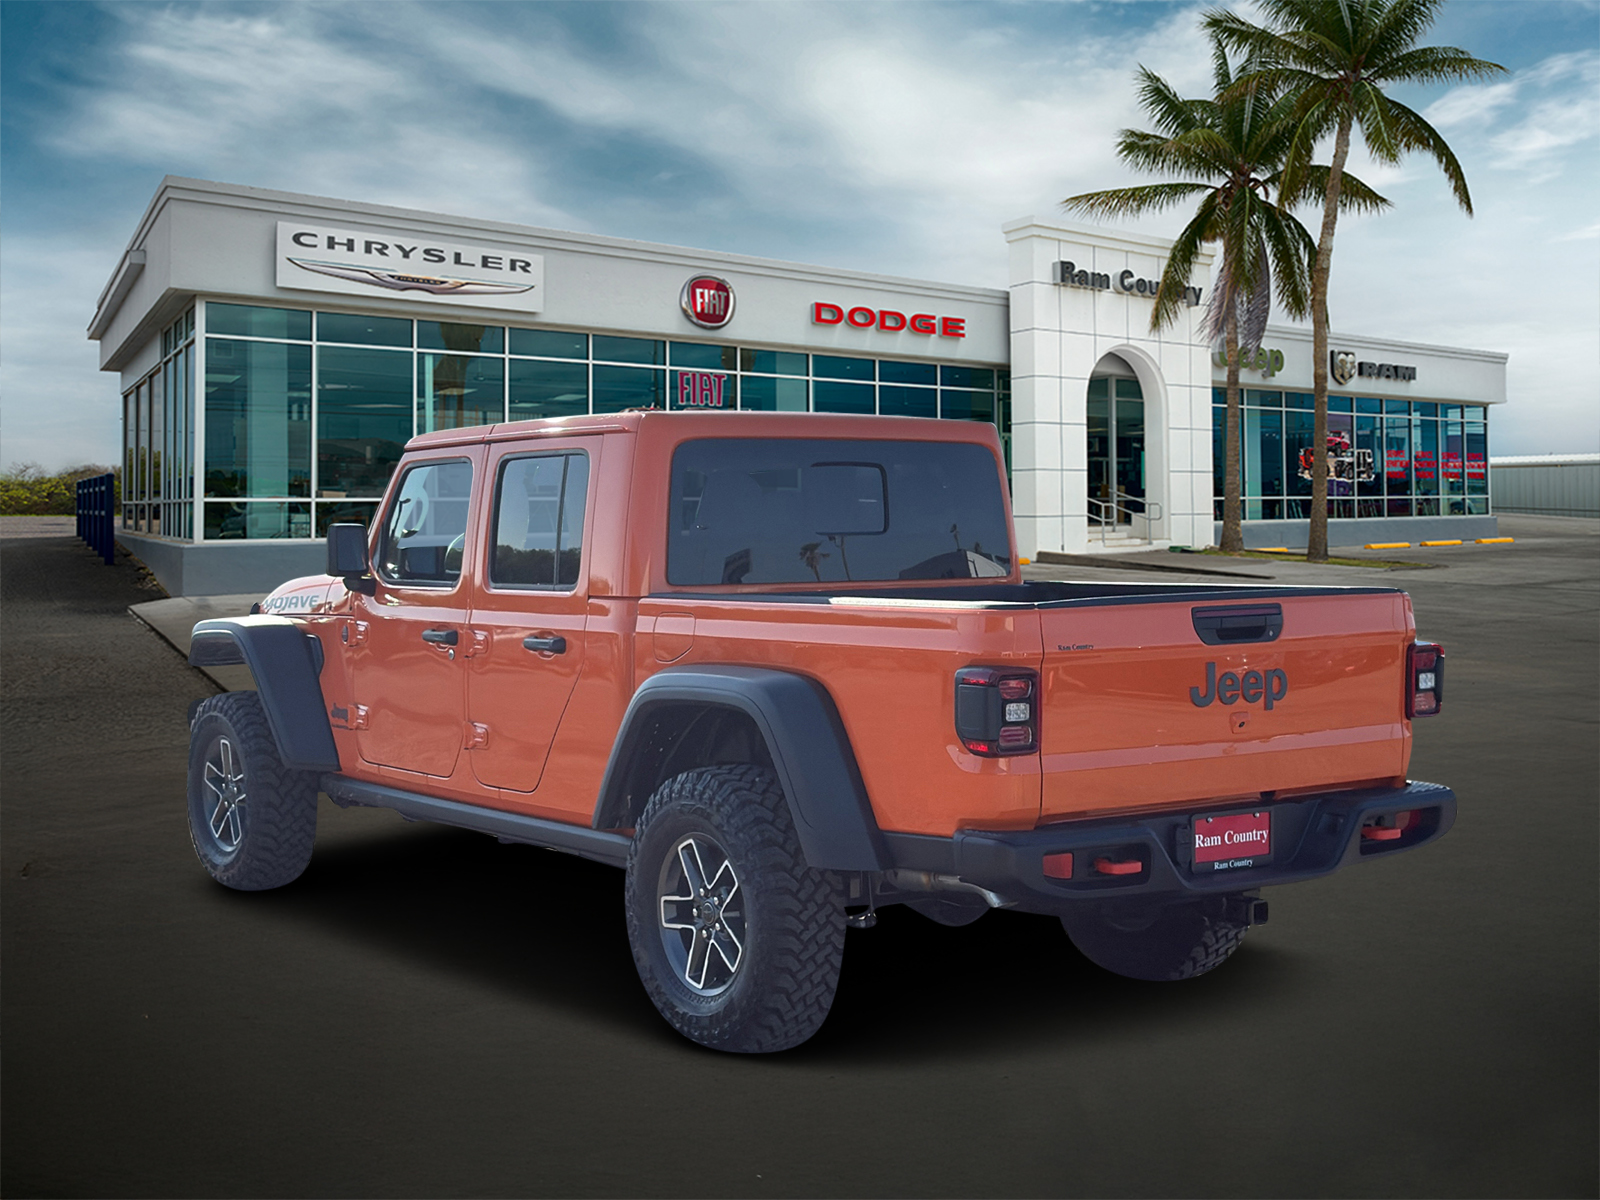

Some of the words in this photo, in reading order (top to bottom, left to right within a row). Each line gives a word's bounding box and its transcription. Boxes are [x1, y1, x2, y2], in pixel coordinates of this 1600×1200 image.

[292, 231, 532, 274] CHRYSLER
[1055, 260, 1110, 290] Ram
[1115, 269, 1203, 307] Coury
[695, 288, 728, 316] FIAT
[812, 301, 966, 339] DODGE
[1358, 362, 1416, 381] RAM
[678, 371, 727, 406] FIAT
[263, 595, 319, 613] MOJAVE
[1189, 661, 1288, 711] Jeep
[1195, 834, 1221, 848] Ram
[1224, 829, 1269, 845] Country
[1214, 861, 1228, 870] Ram
[1229, 859, 1253, 868] Country
